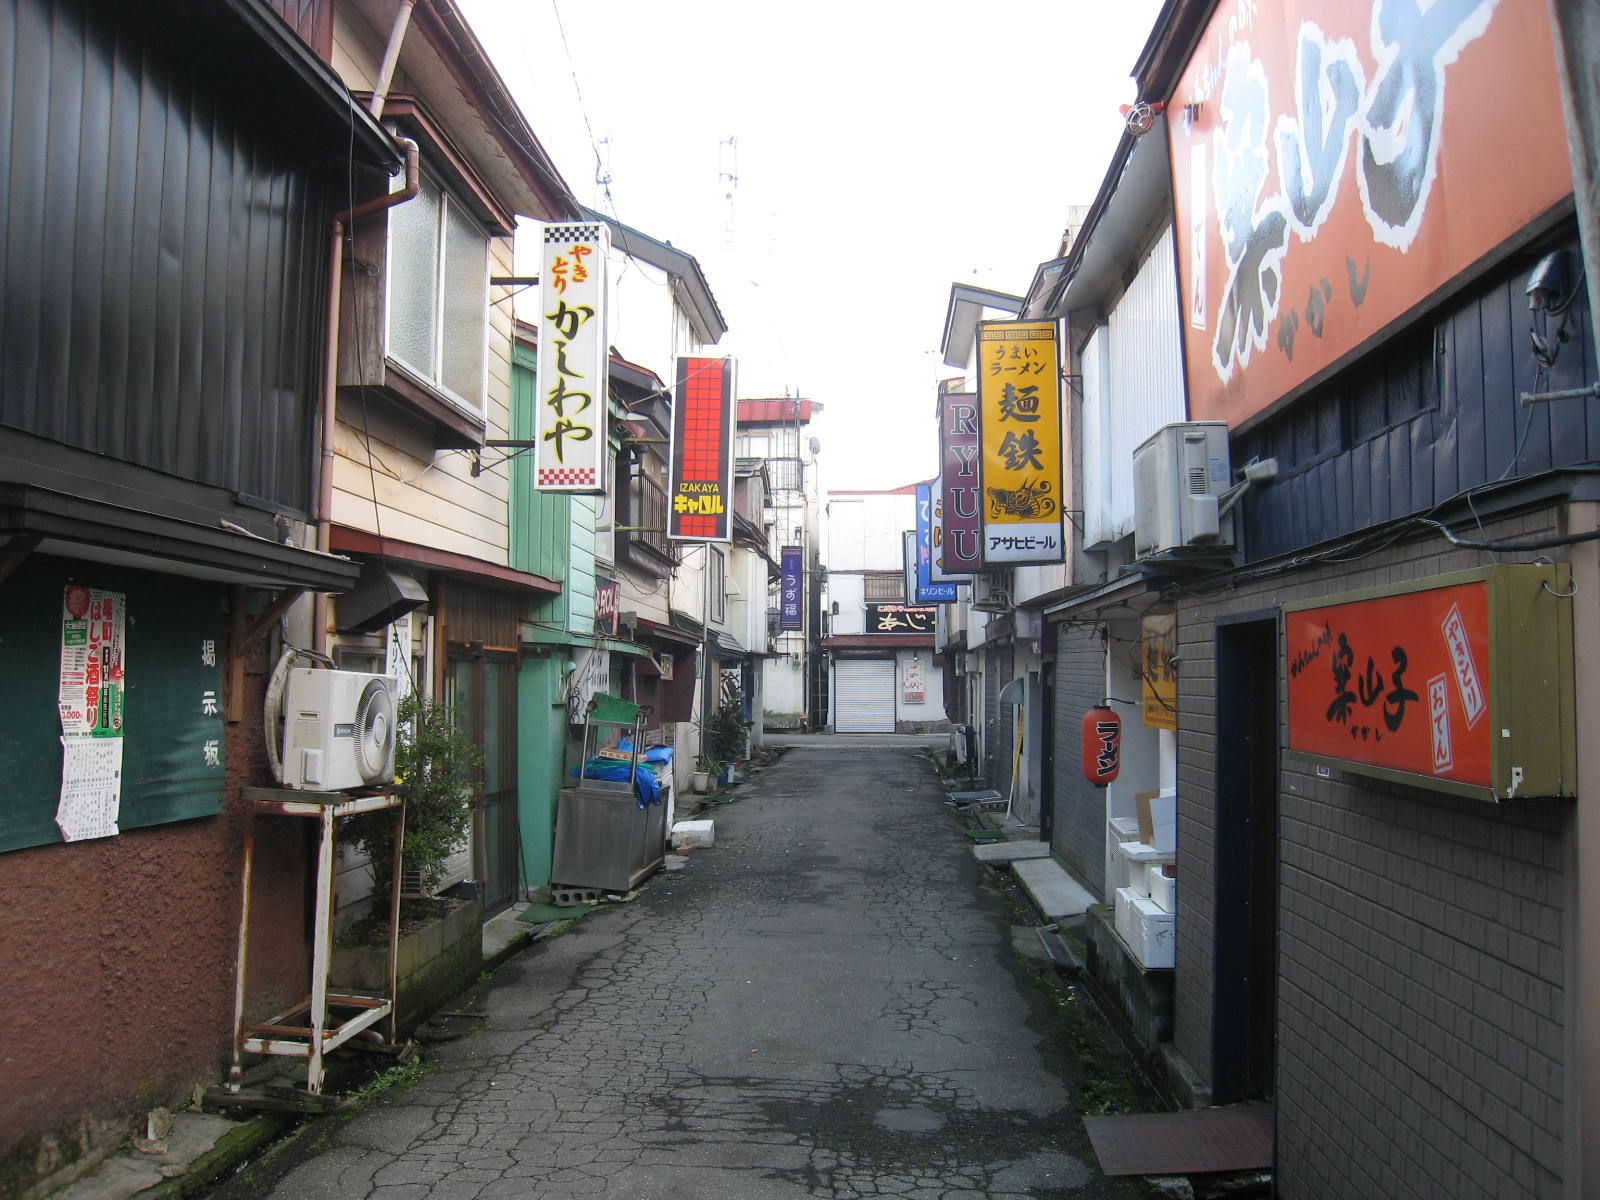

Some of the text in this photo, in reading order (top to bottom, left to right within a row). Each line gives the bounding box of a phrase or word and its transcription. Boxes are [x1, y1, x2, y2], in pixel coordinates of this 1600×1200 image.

[990, 362, 1047, 376] ラーメン
[996, 345, 1038, 360] うまい
[544, 300, 595, 464] かしわや
[998, 382, 1044, 471] 麺鉄
[674, 494, 724, 515] キャロル
[680, 482, 720, 494] IZAKAYA
[989, 535, 1057, 551] アサヒビール
[784, 574, 798, 617] うず福
[920, 586, 955, 596] キリンビール
[1326, 631, 1420, 733] 案山子
[1448, 620, 1477, 713] やきとり
[201, 639, 221, 766] 掲示板
[1432, 684, 1448, 762] おでん
[1096, 721, 1119, 776] ラーメン
